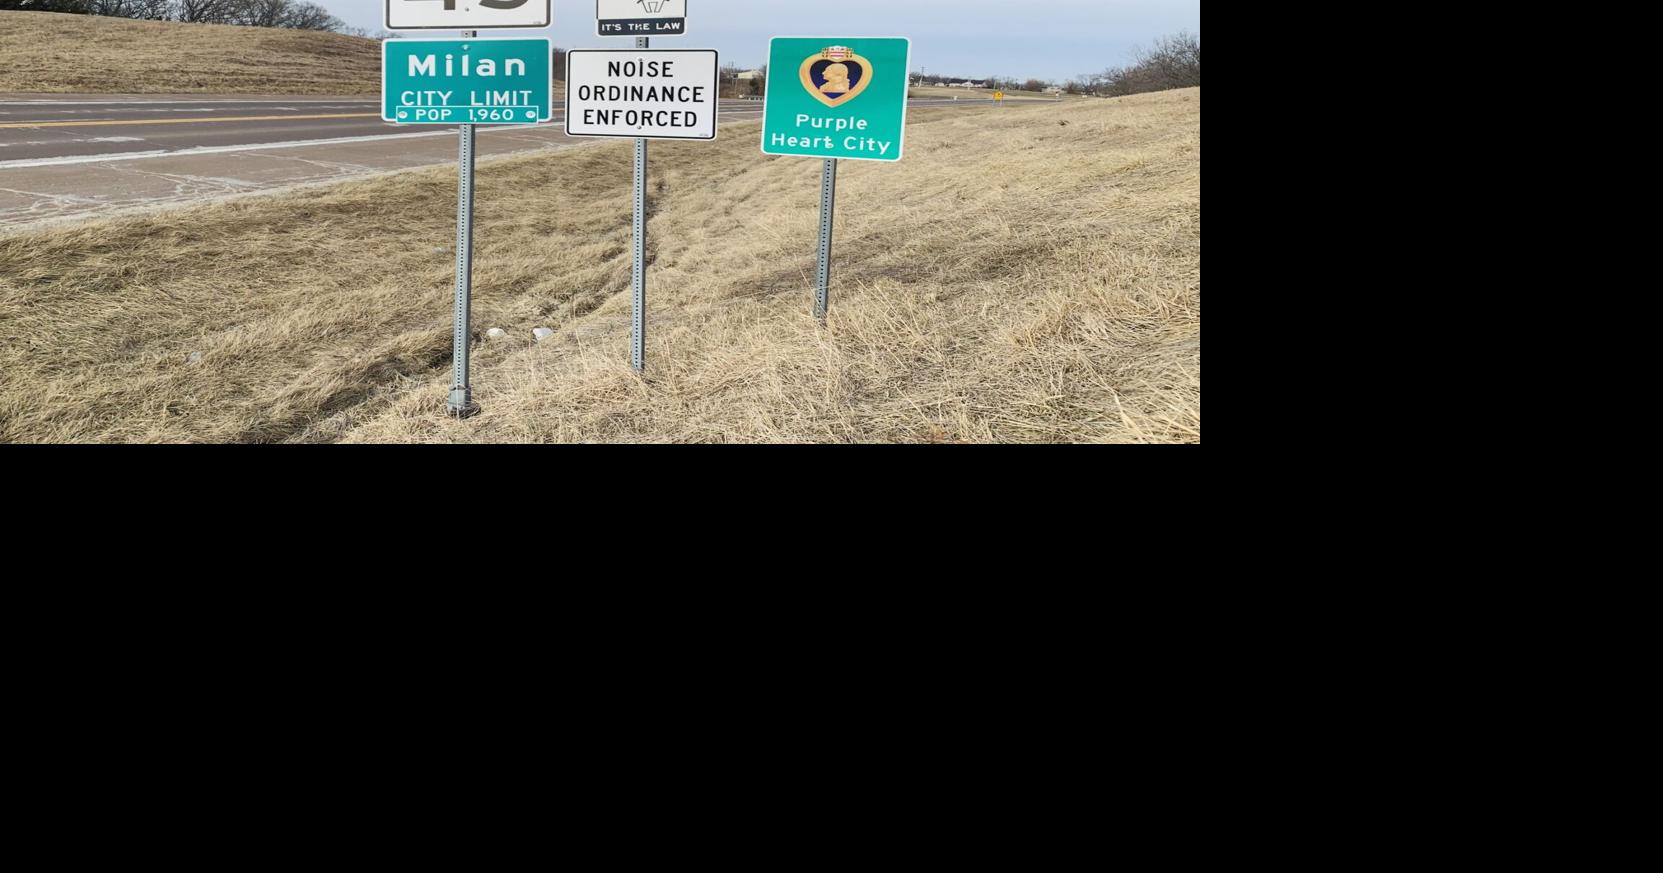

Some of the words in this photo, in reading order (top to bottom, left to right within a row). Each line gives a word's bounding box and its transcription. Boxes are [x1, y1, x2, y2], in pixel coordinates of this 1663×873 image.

[601, 23, 622, 31] IT'S
[628, 23, 650, 31] THE
[656, 22, 681, 30] LAW
[408, 54, 526, 77] Milan
[608, 61, 674, 78] NOISE
[401, 90, 453, 106] CITY
[470, 90, 533, 106] LIMIT
[578, 85, 705, 103] ORDINANCE
[415, 109, 452, 121] POP
[468, 108, 514, 122] 1,960
[583, 109, 697, 128] ENFORCED
[796, 113, 868, 132] Purple
[771, 132, 834, 149] Heart
[843, 136, 891, 155] City
